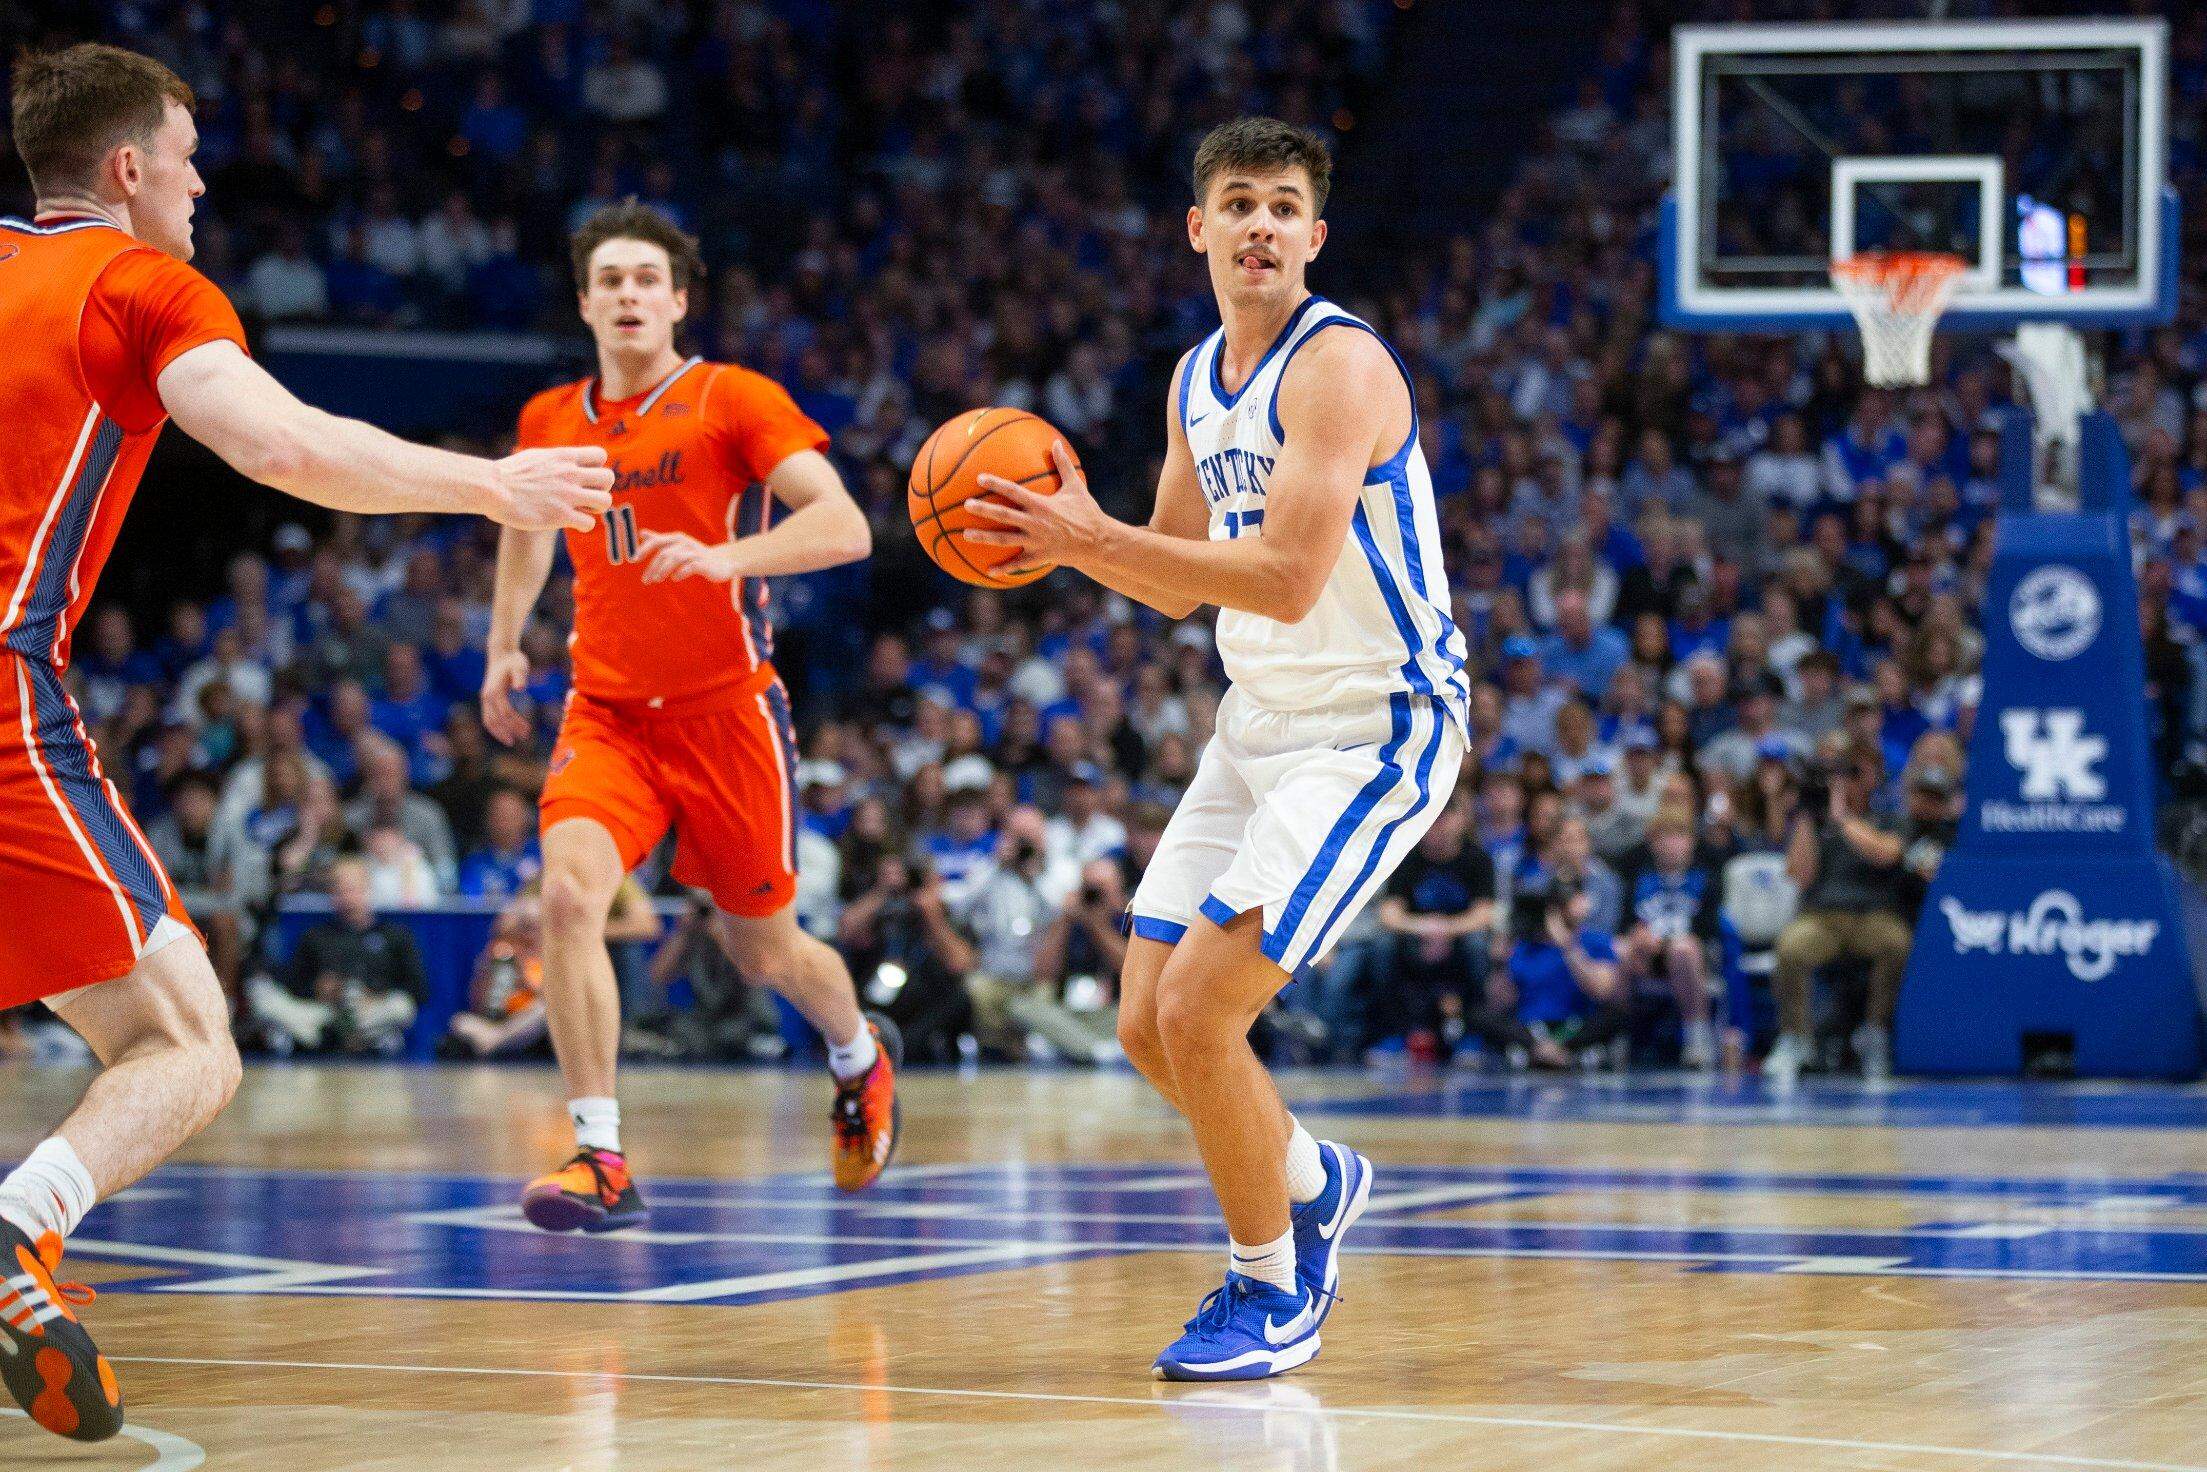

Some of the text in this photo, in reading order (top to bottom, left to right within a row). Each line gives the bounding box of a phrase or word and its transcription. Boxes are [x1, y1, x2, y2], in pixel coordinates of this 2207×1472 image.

[611, 450, 684, 491] knell
[603, 503, 639, 564] 11
[2001, 709, 2107, 799] UK
[2008, 890, 2159, 981] Kroger
